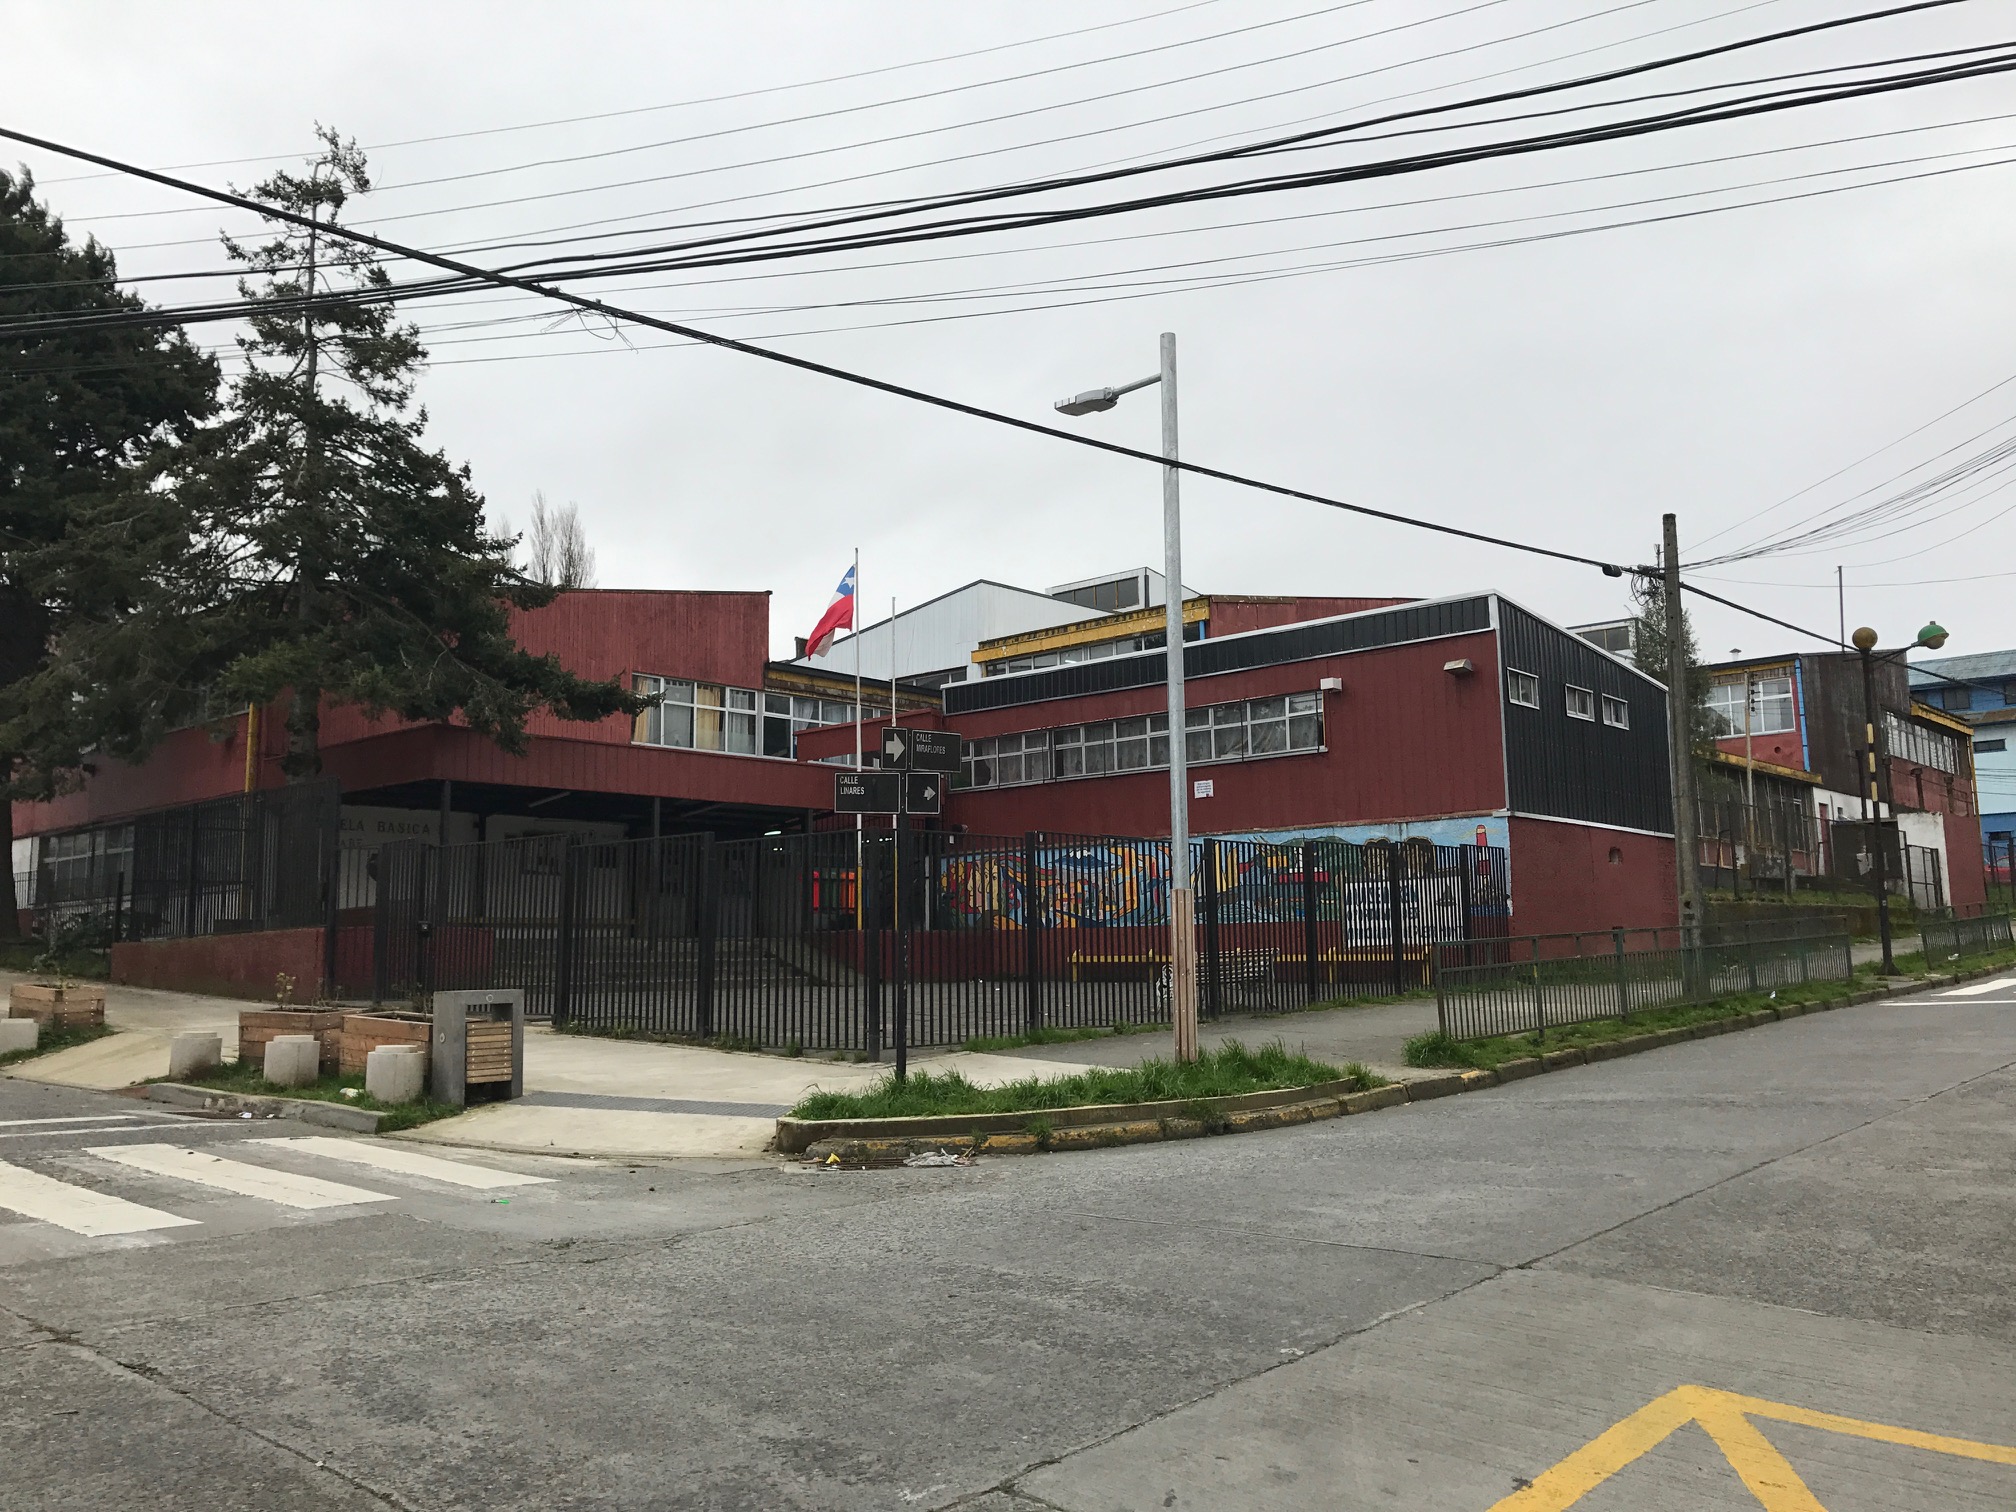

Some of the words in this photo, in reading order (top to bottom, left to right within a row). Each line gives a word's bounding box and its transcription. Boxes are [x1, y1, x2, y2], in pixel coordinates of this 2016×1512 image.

[916, 733, 932, 743] CALLE
[916, 744, 946, 755] MIRAFLORES
[839, 776, 859, 784] CALLE
[840, 786, 865, 795] LINARES
[377, 821, 430, 834] BASICA
